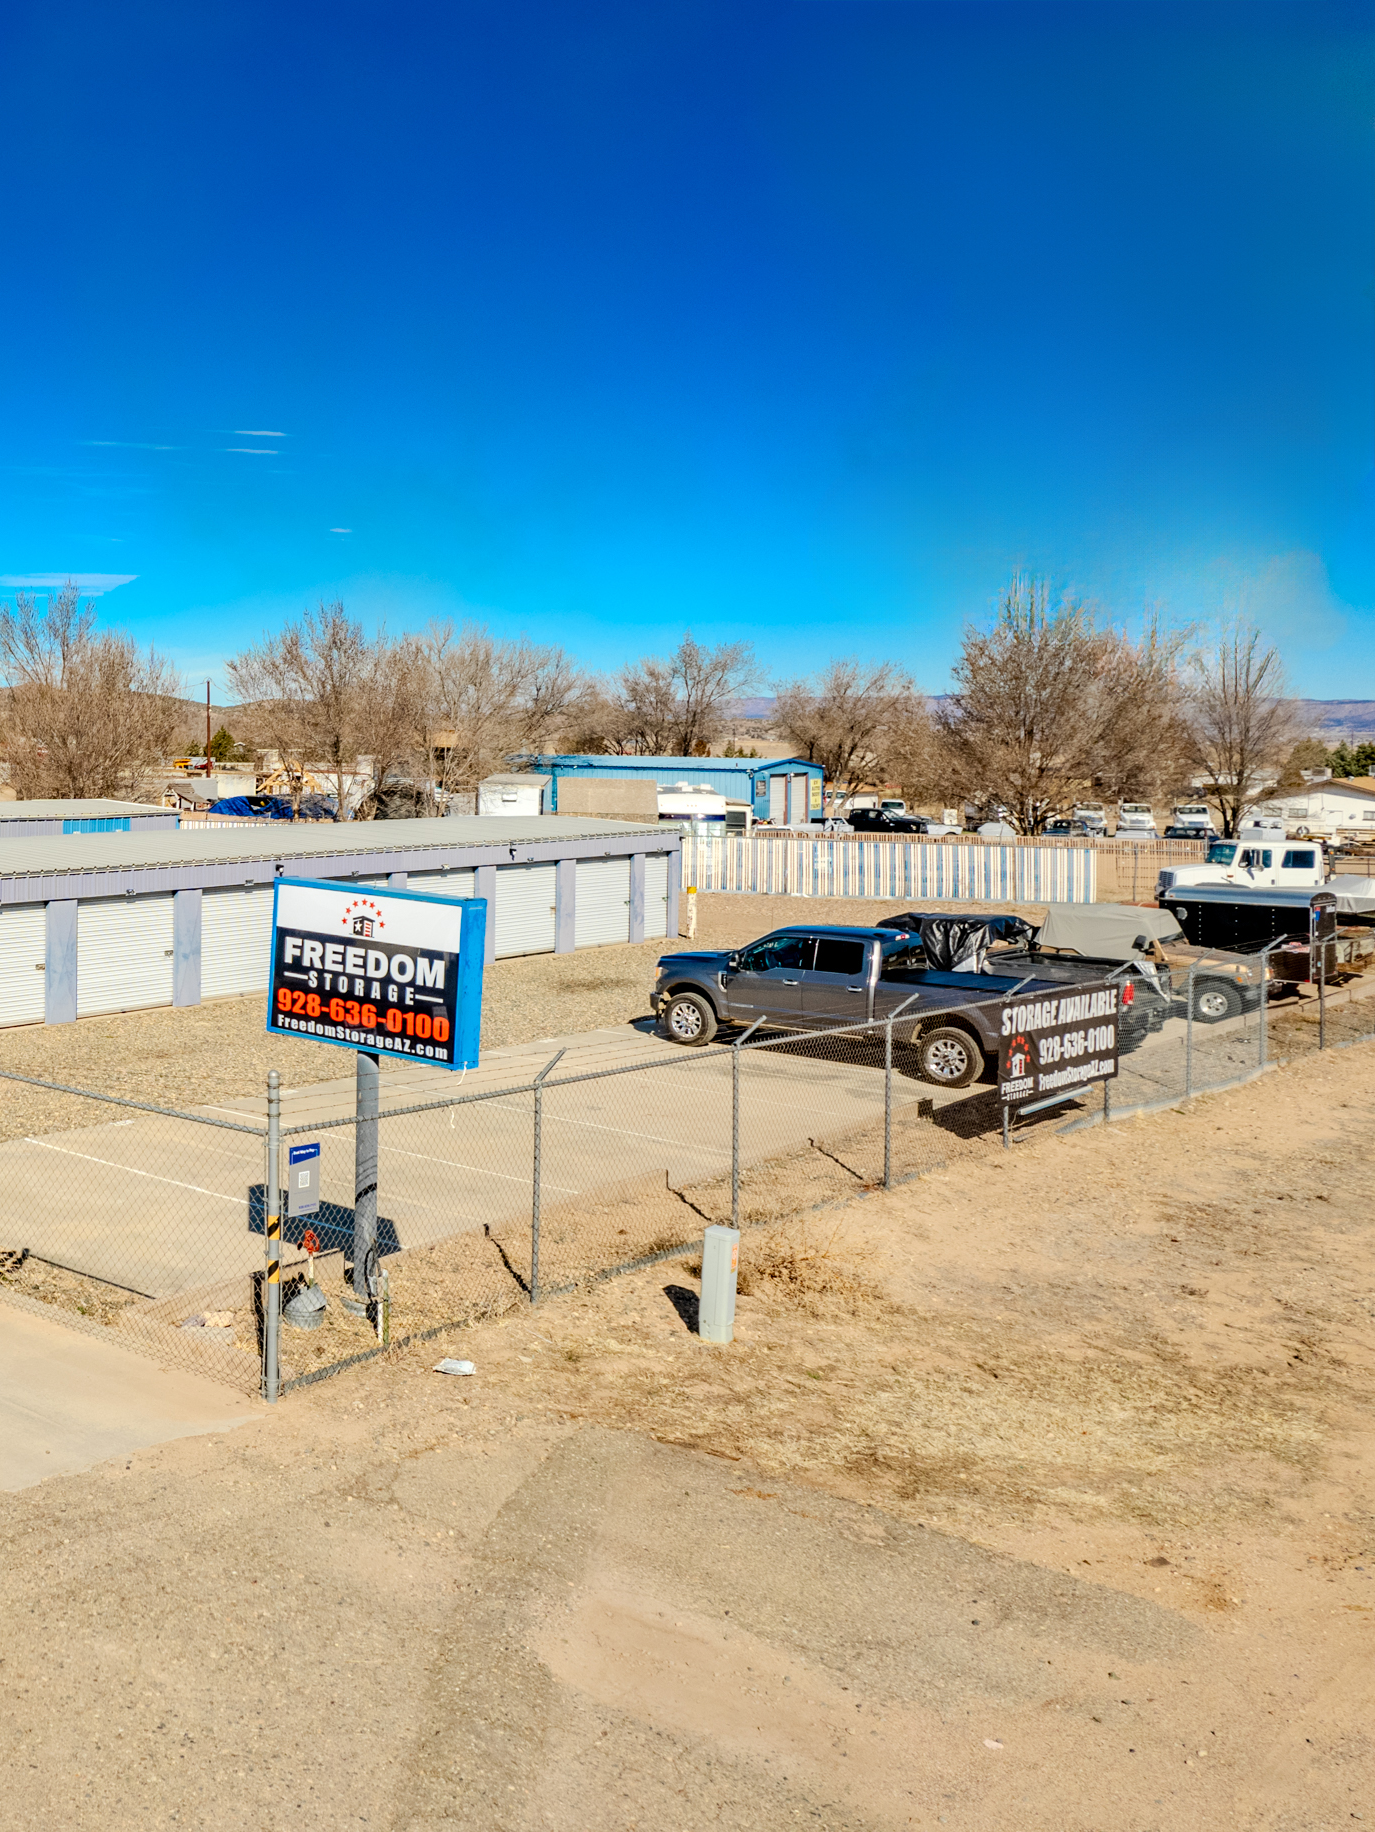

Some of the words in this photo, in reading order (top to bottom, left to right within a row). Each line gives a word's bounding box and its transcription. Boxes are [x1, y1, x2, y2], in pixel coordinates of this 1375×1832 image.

[284, 936, 445, 989] FREEDOM
[308, 971, 414, 1005] STORAGE
[277, 987, 449, 1042] 928-636-0100
[1001, 1000, 1058, 1036] STORAGE
[1058, 989, 1117, 1025] AVAILABLE
[278, 1014, 448, 1060] FreedomStorageAZ.com
[1039, 1024, 1115, 1065] 928-636-0100
[1001, 1077, 1034, 1094] FREEDOM
